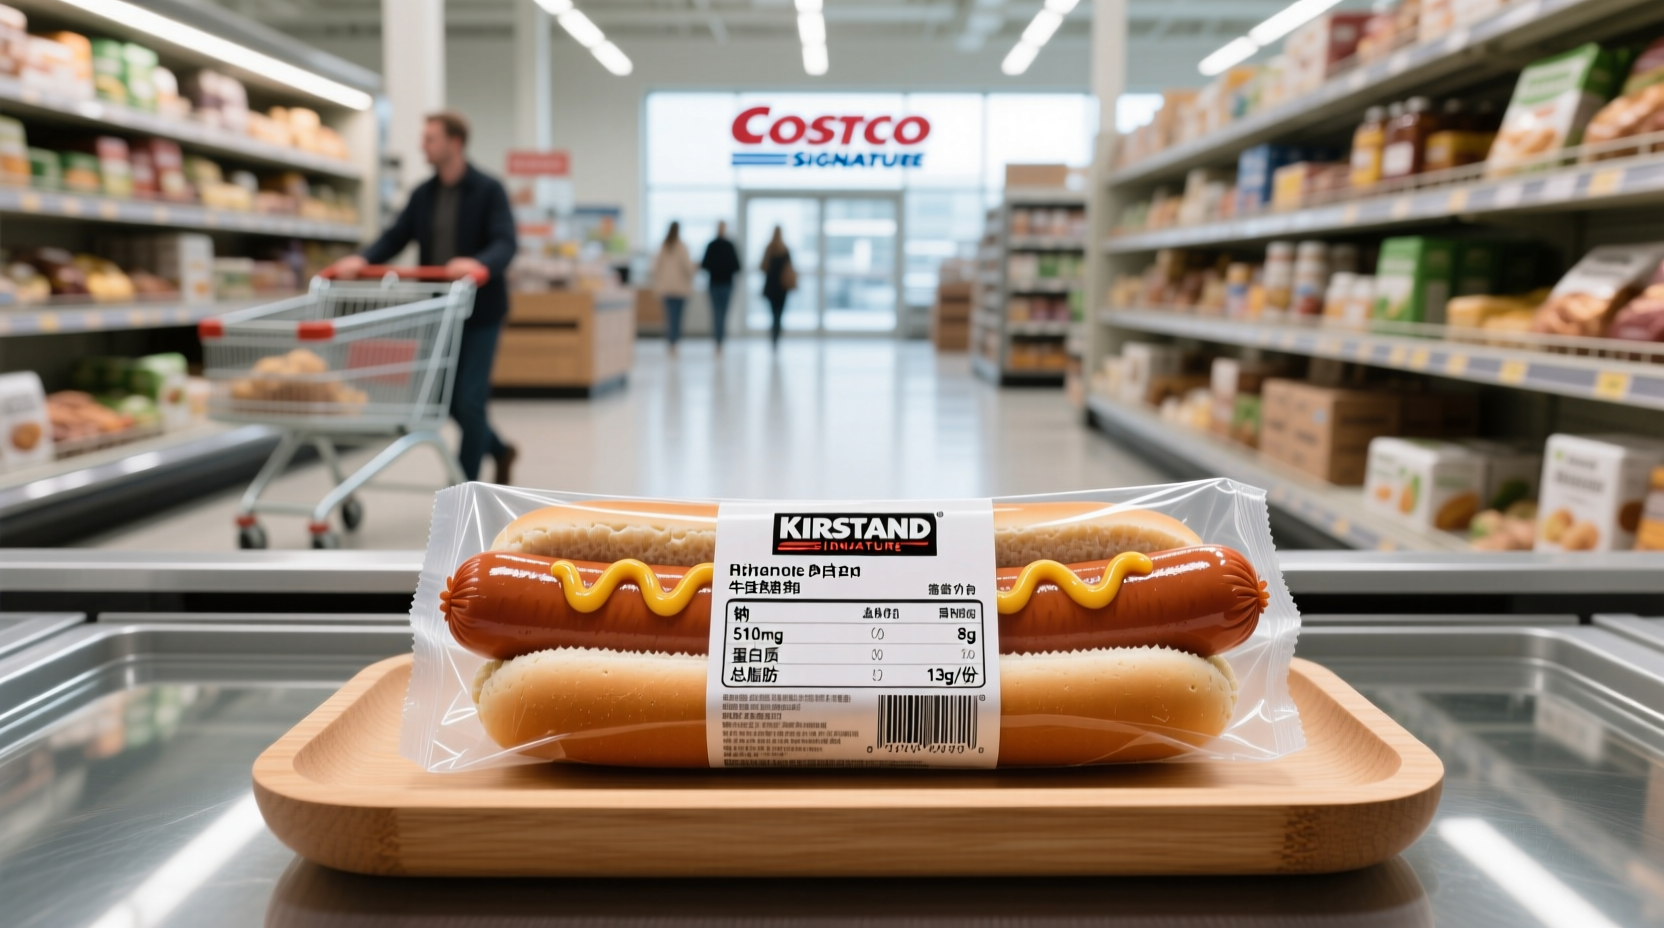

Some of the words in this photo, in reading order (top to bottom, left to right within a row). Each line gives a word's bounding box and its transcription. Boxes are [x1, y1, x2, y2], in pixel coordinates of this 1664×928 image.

[732, 106, 931, 145] COSTCO
[779, 516, 931, 540] KIRSTAND
[733, 605, 750, 622] 钠
[733, 626, 783, 645] 510mg
[957, 627, 976, 644] 8g
[927, 665, 979, 685] 13g/份
